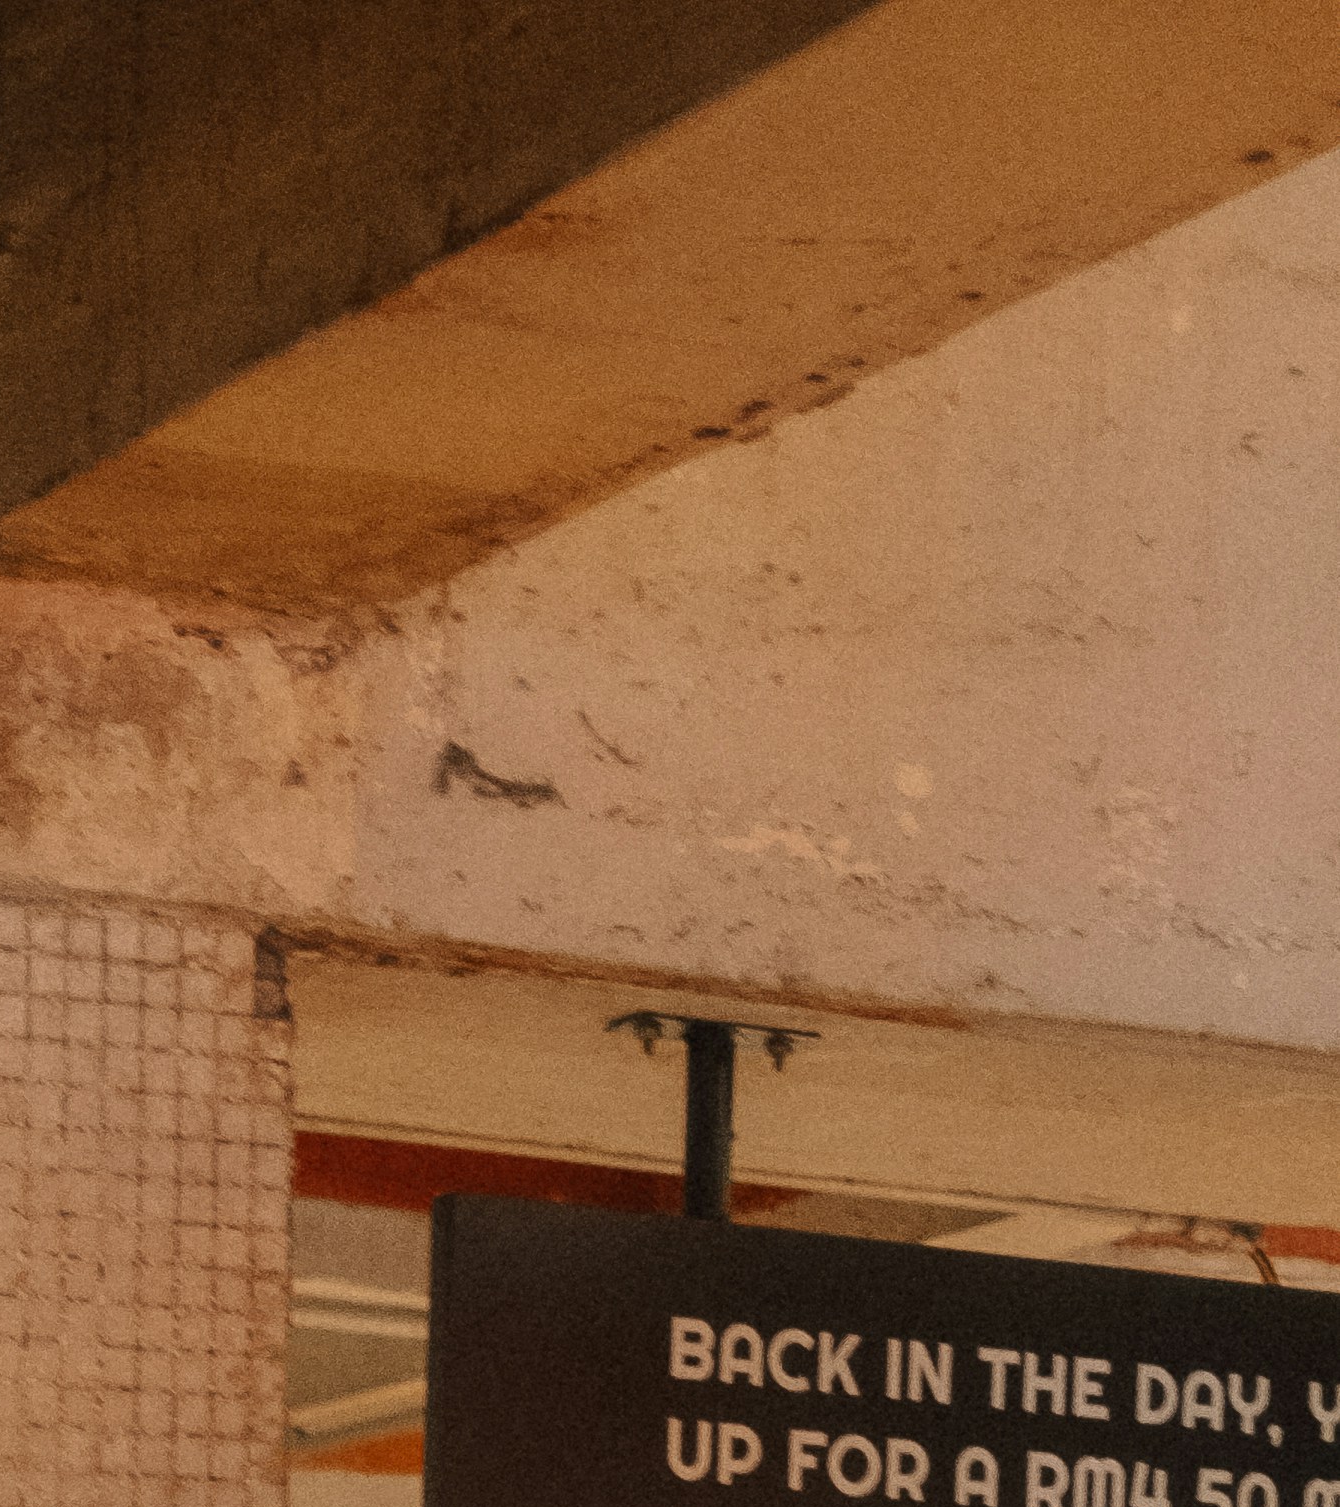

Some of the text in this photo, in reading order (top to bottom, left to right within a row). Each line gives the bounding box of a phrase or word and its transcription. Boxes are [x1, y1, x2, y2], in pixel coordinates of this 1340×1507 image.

[669, 1315, 863, 1396] BACK
[885, 1337, 955, 1405] IN
[977, 1346, 1113, 1421] THE
[1134, 1361, 1285, 1448] DAY,
[665, 1416, 764, 1487] UP
[786, 1428, 929, 1502] FOR
[952, 1445, 1001, 1507] A
